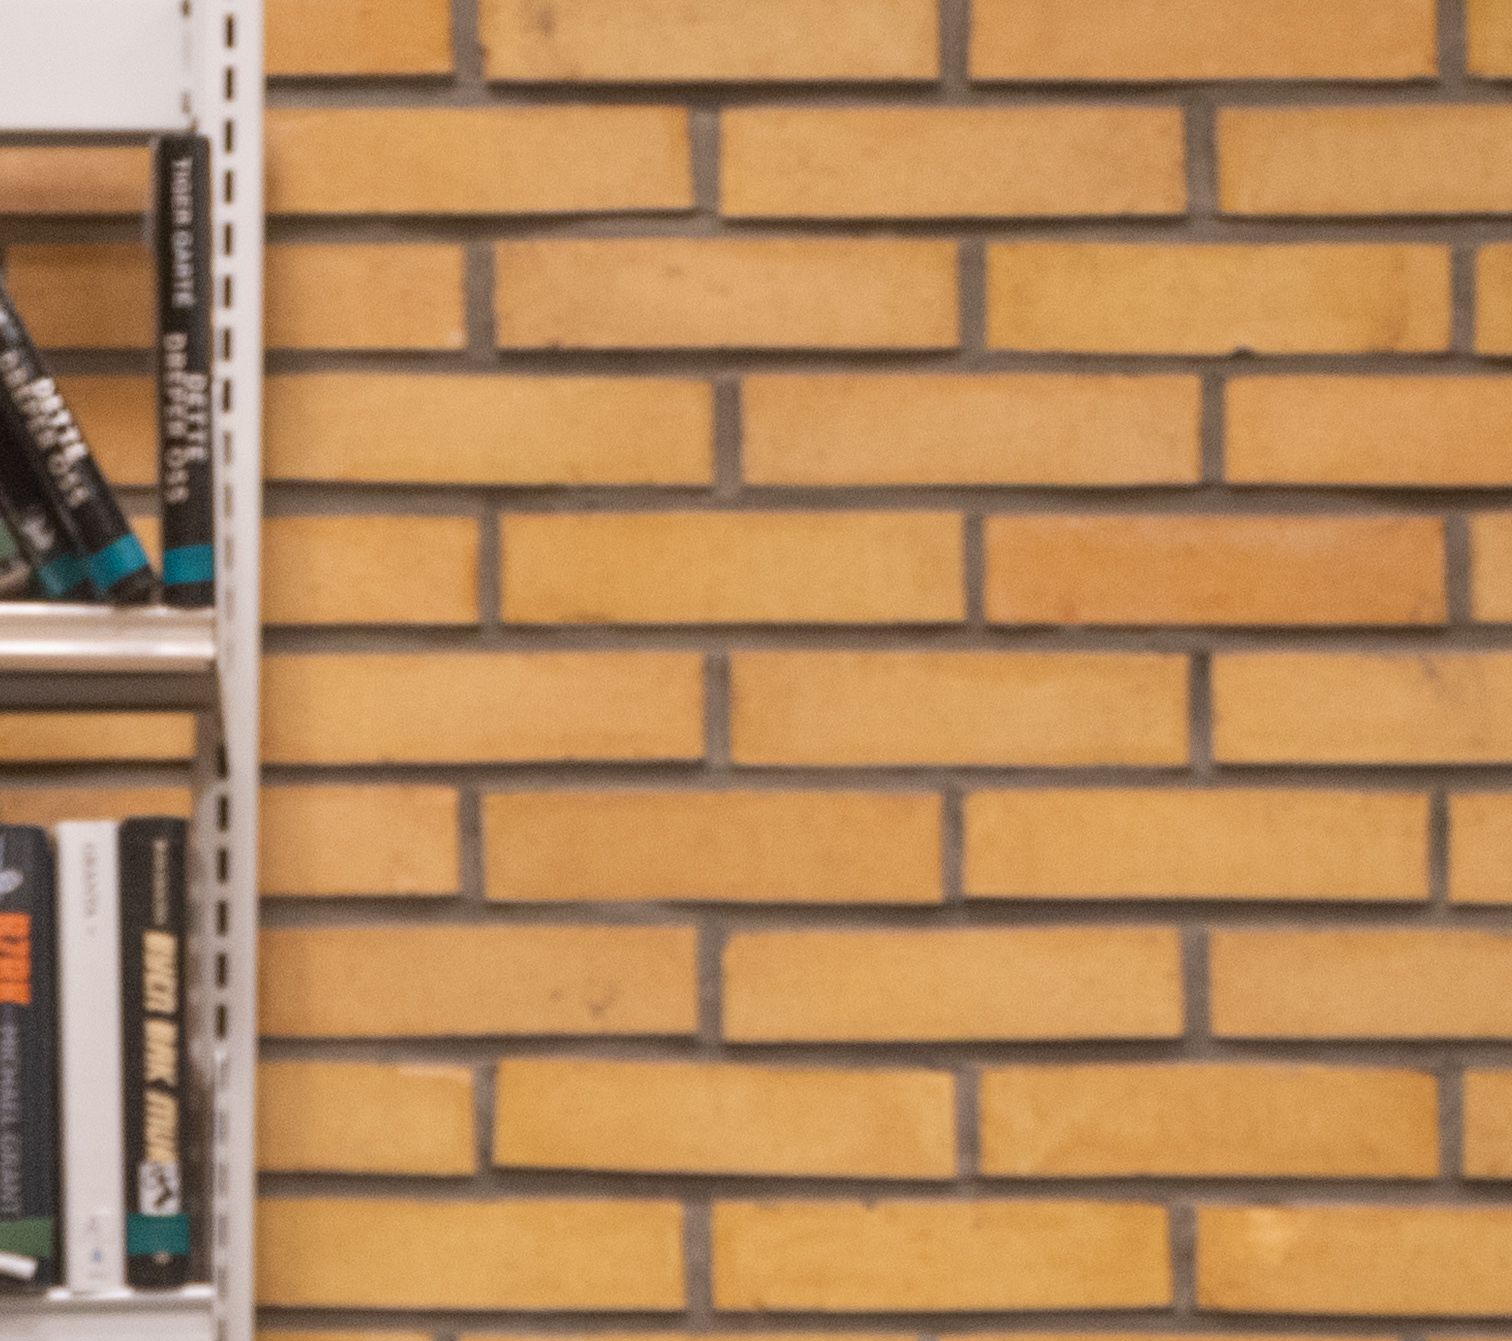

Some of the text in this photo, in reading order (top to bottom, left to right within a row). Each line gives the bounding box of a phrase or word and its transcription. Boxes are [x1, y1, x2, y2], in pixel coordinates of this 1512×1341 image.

[171, 156, 192, 224] TIGER
[26, 374, 91, 465] DETTE
[186, 373, 206, 460] DETTE
